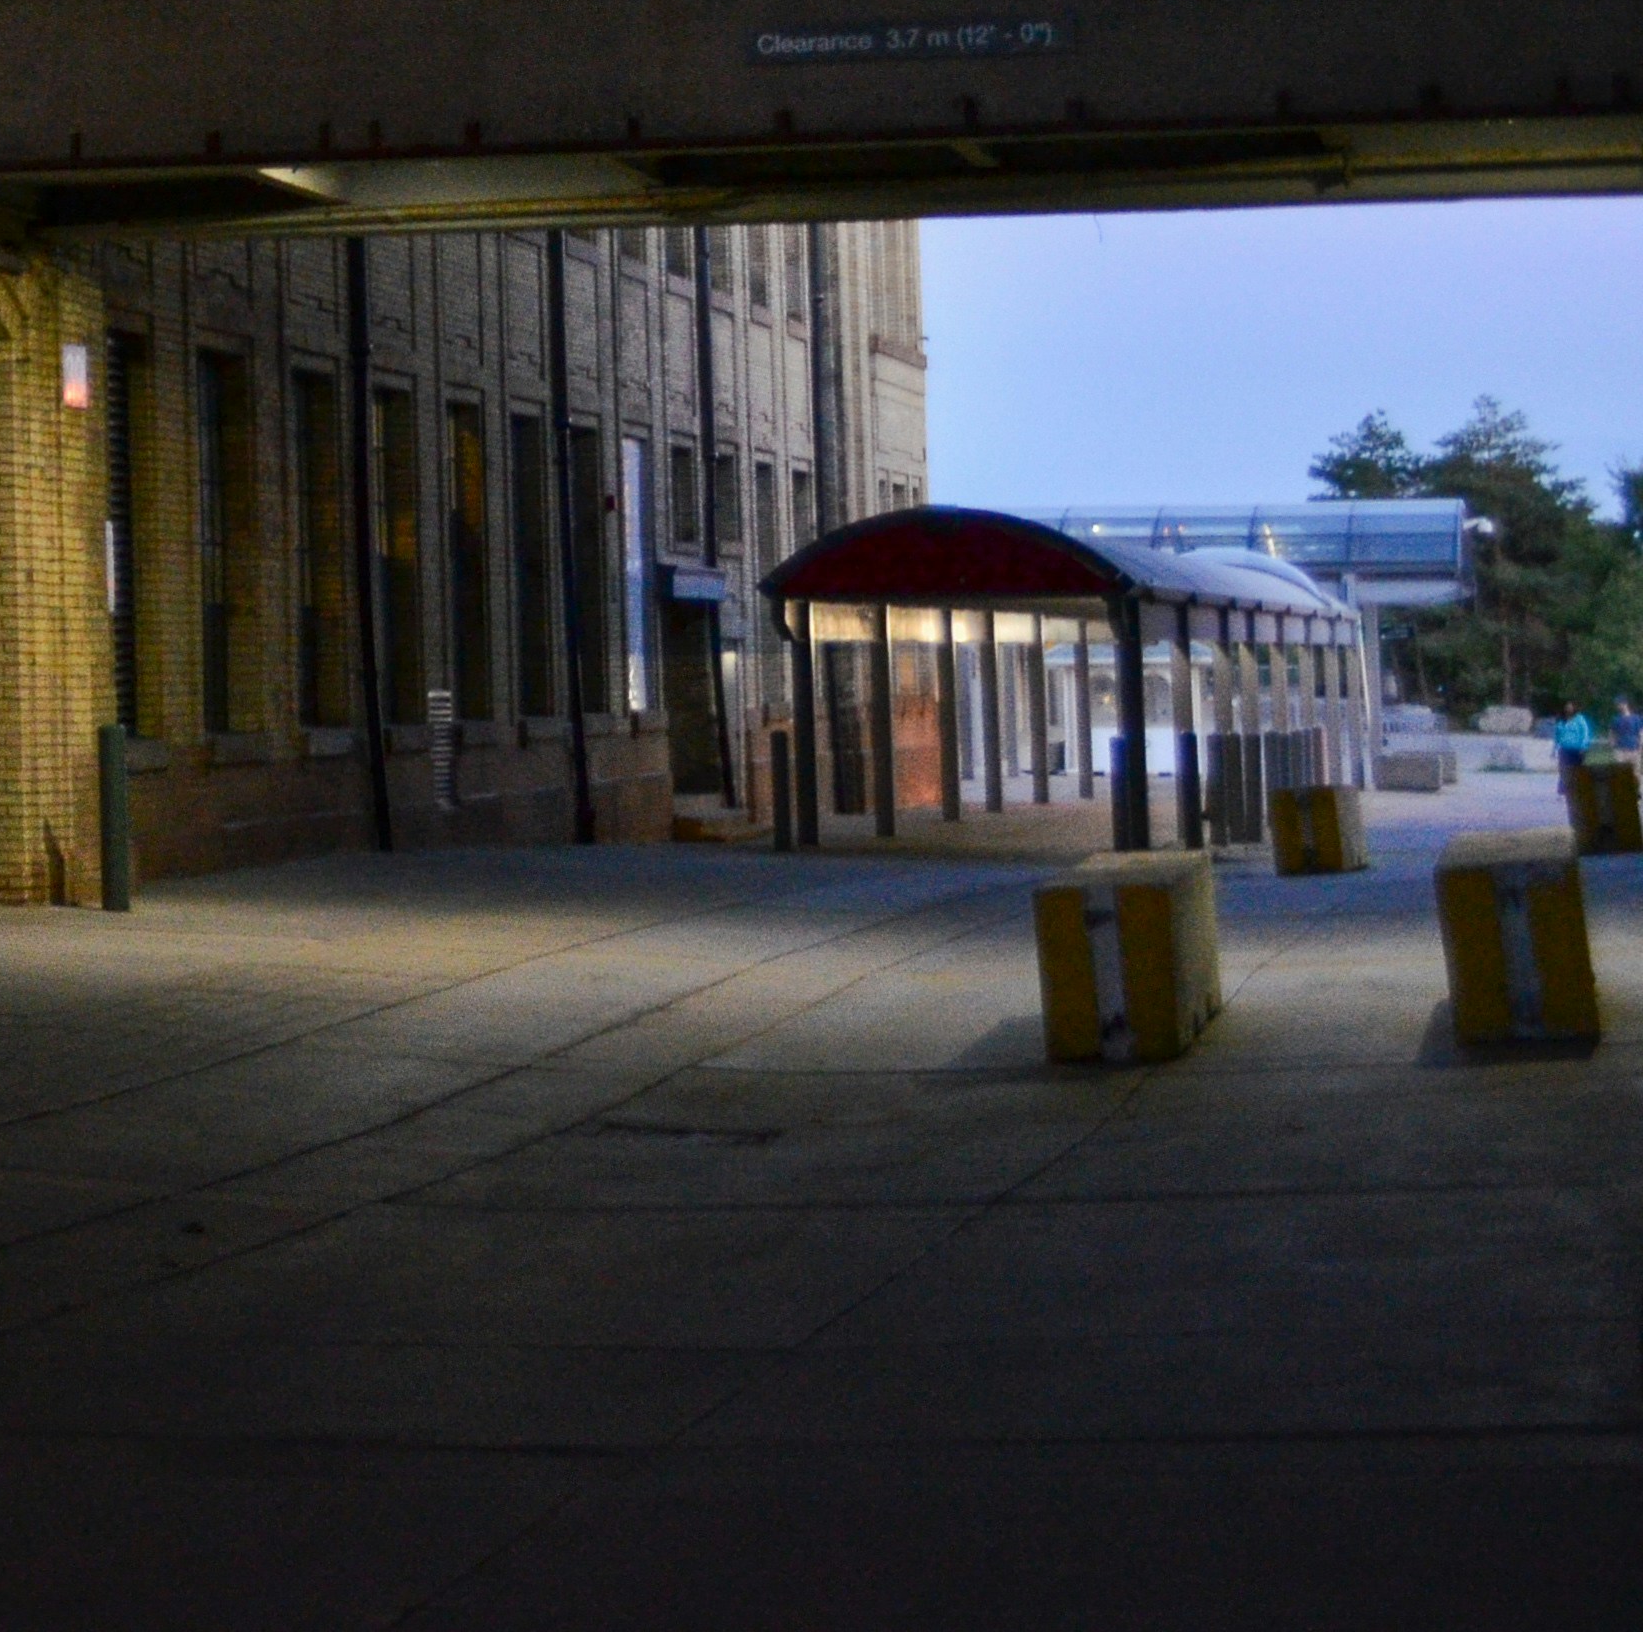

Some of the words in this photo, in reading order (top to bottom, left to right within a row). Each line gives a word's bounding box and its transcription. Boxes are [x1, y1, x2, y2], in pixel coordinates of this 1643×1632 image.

[757, 32, 873, 55] Clearance
[885, 27, 920, 49] 3.7
[926, 28, 950, 47] m
